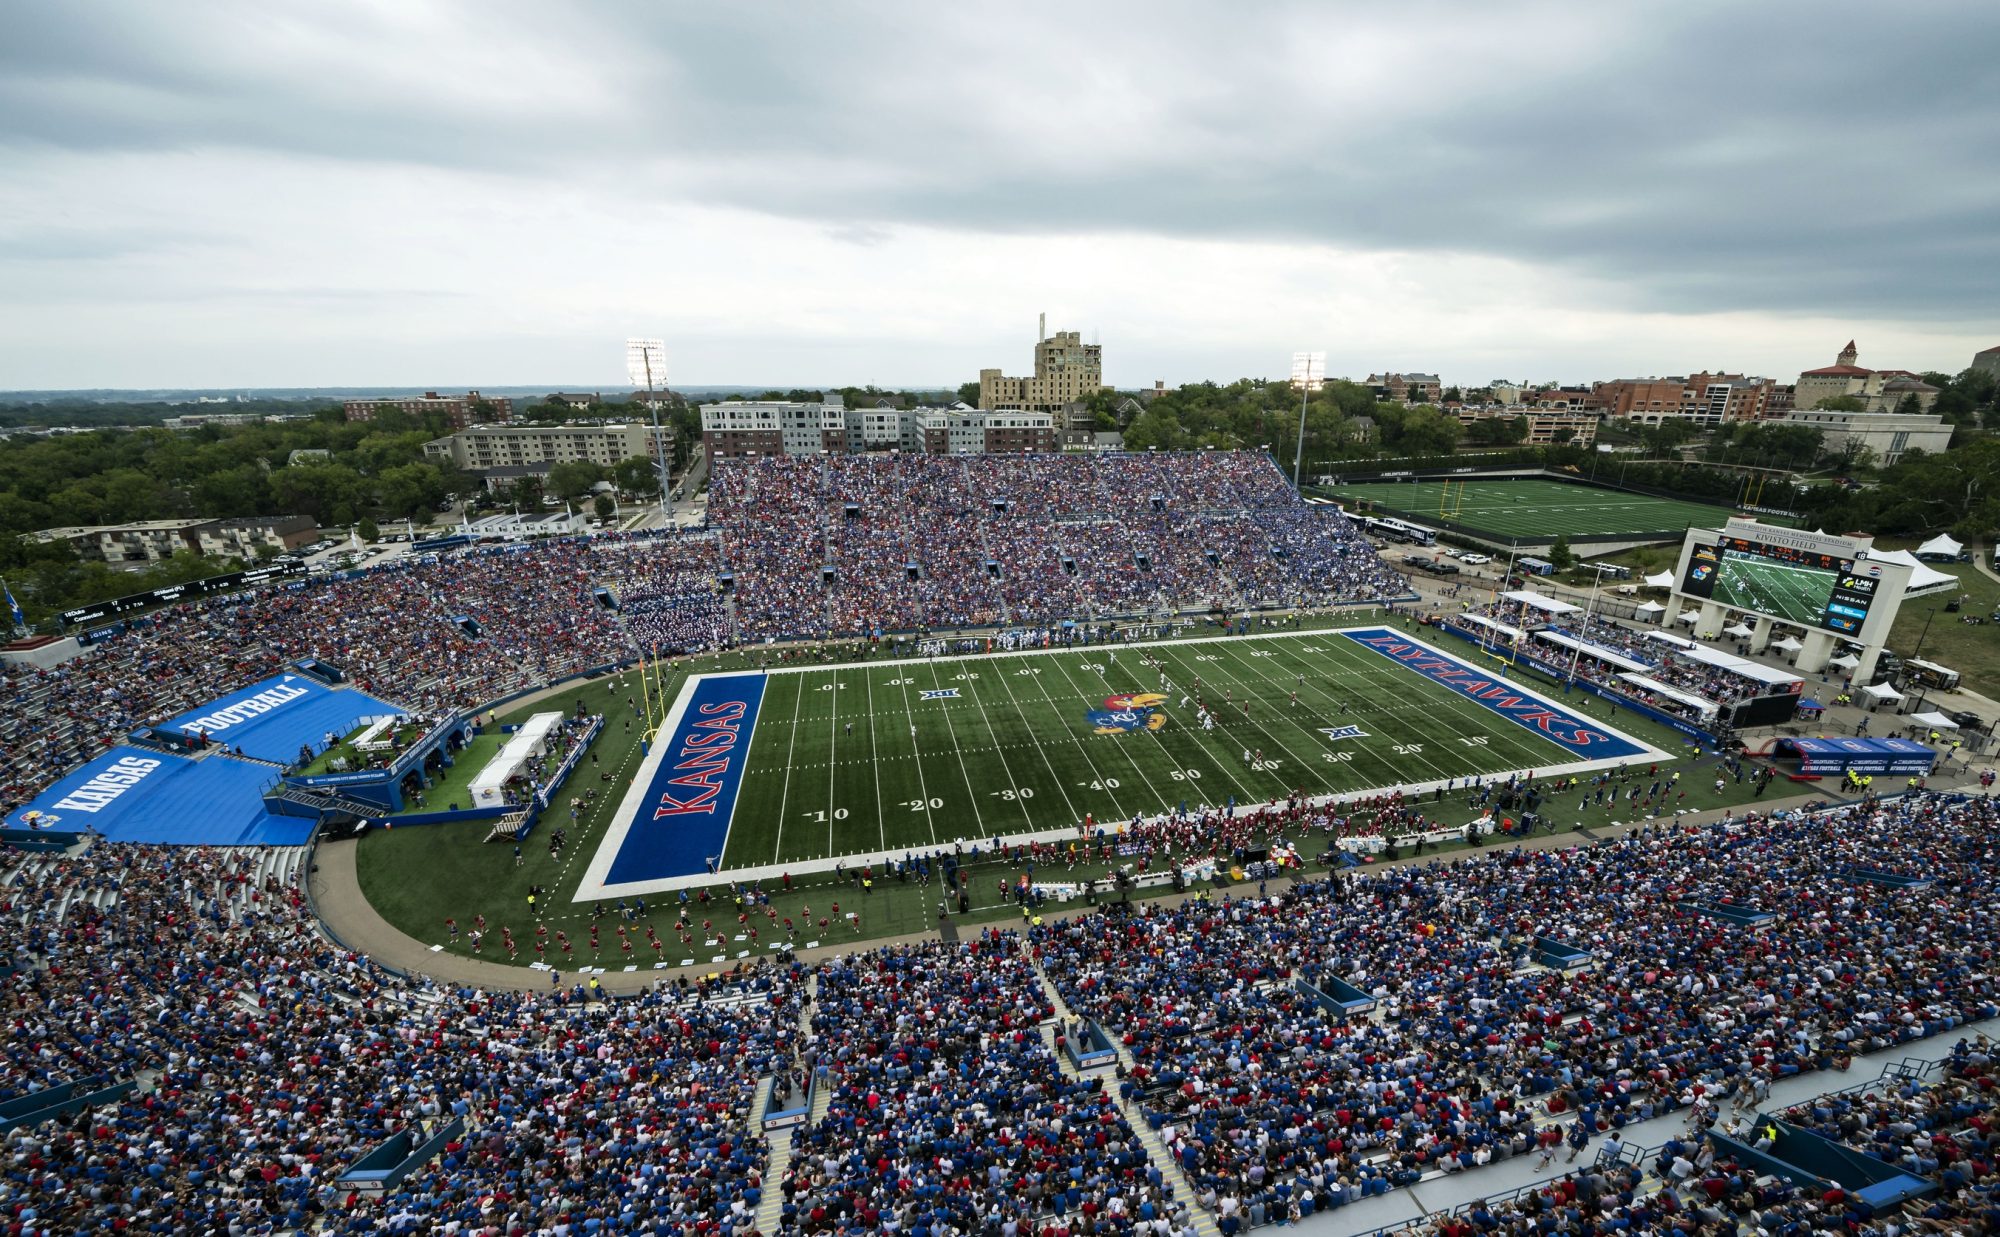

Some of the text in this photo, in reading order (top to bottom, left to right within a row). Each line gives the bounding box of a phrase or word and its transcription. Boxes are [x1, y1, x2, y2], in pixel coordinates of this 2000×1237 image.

[1743, 505, 1799, 518] KANSAS FOOTBALL
[1755, 533, 1789, 545] KIVISTO
[1791, 539, 1817, 550] FIELD
[1791, 531, 1822, 541] MEMORIAL
[1824, 537, 1853, 546] STADIUM
[1853, 584, 1871, 592] Health
[1855, 578, 1873, 588] LMH
[1835, 594, 1868, 605] NISSAN
[1534, 663, 1557, 678] Meritrust
[1357, 636, 1610, 745] JAYHAWKS
[179, 684, 309, 736] FOOTBALL
[1673, 722, 1698, 735] NISSAN
[1457, 736, 1489, 747] 10
[1392, 743, 1422, 755] 20
[652, 700, 747, 821] KANSAS
[1321, 751, 1353, 763] 30
[1251, 759, 1280, 772] 40
[1169, 769, 1202, 782] 50
[52, 756, 162, 813] KANSAS
[1089, 778, 1121, 791] 40
[1001, 787, 1035, 801] 30
[910, 797, 945, 812] 20
[811, 807, 850, 824] 10
